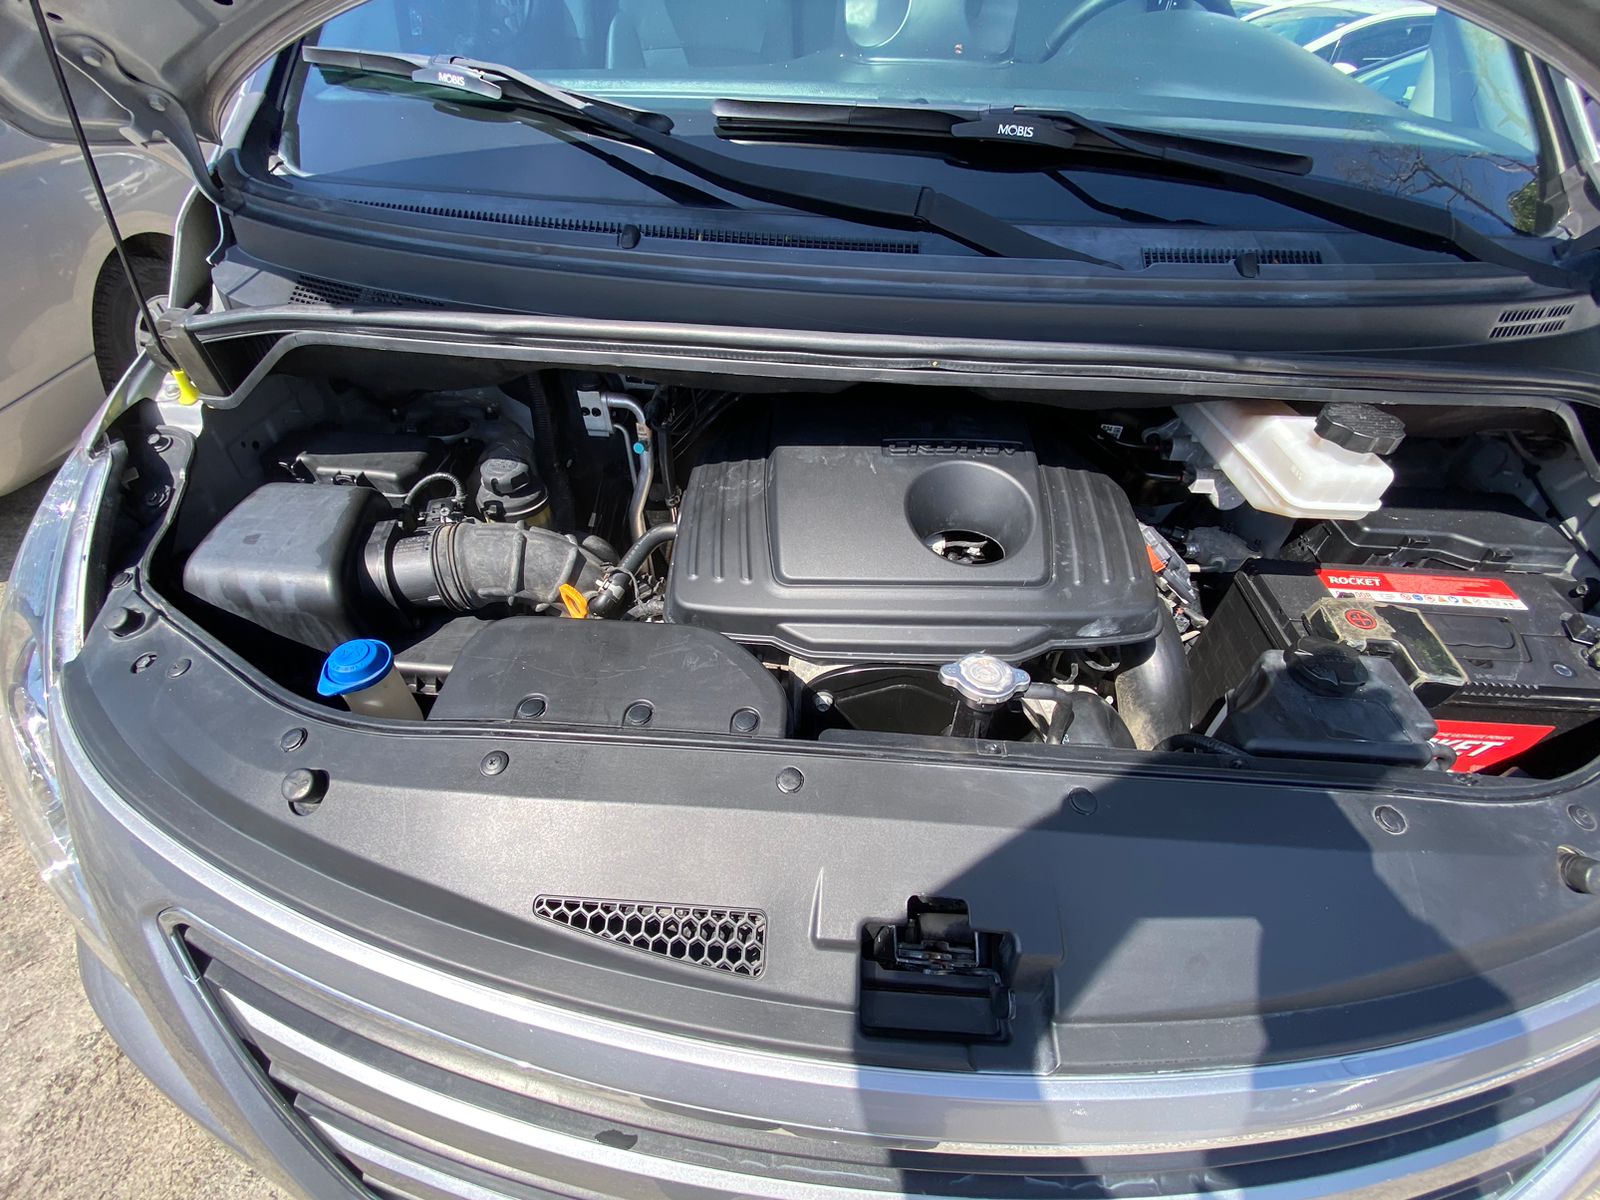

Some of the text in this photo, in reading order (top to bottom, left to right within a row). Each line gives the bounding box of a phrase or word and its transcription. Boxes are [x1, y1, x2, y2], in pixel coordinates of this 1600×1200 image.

[438, 72, 465, 86] MOBIS
[997, 124, 1034, 138] MOBIS
[1327, 576, 1381, 587] ROCKET
